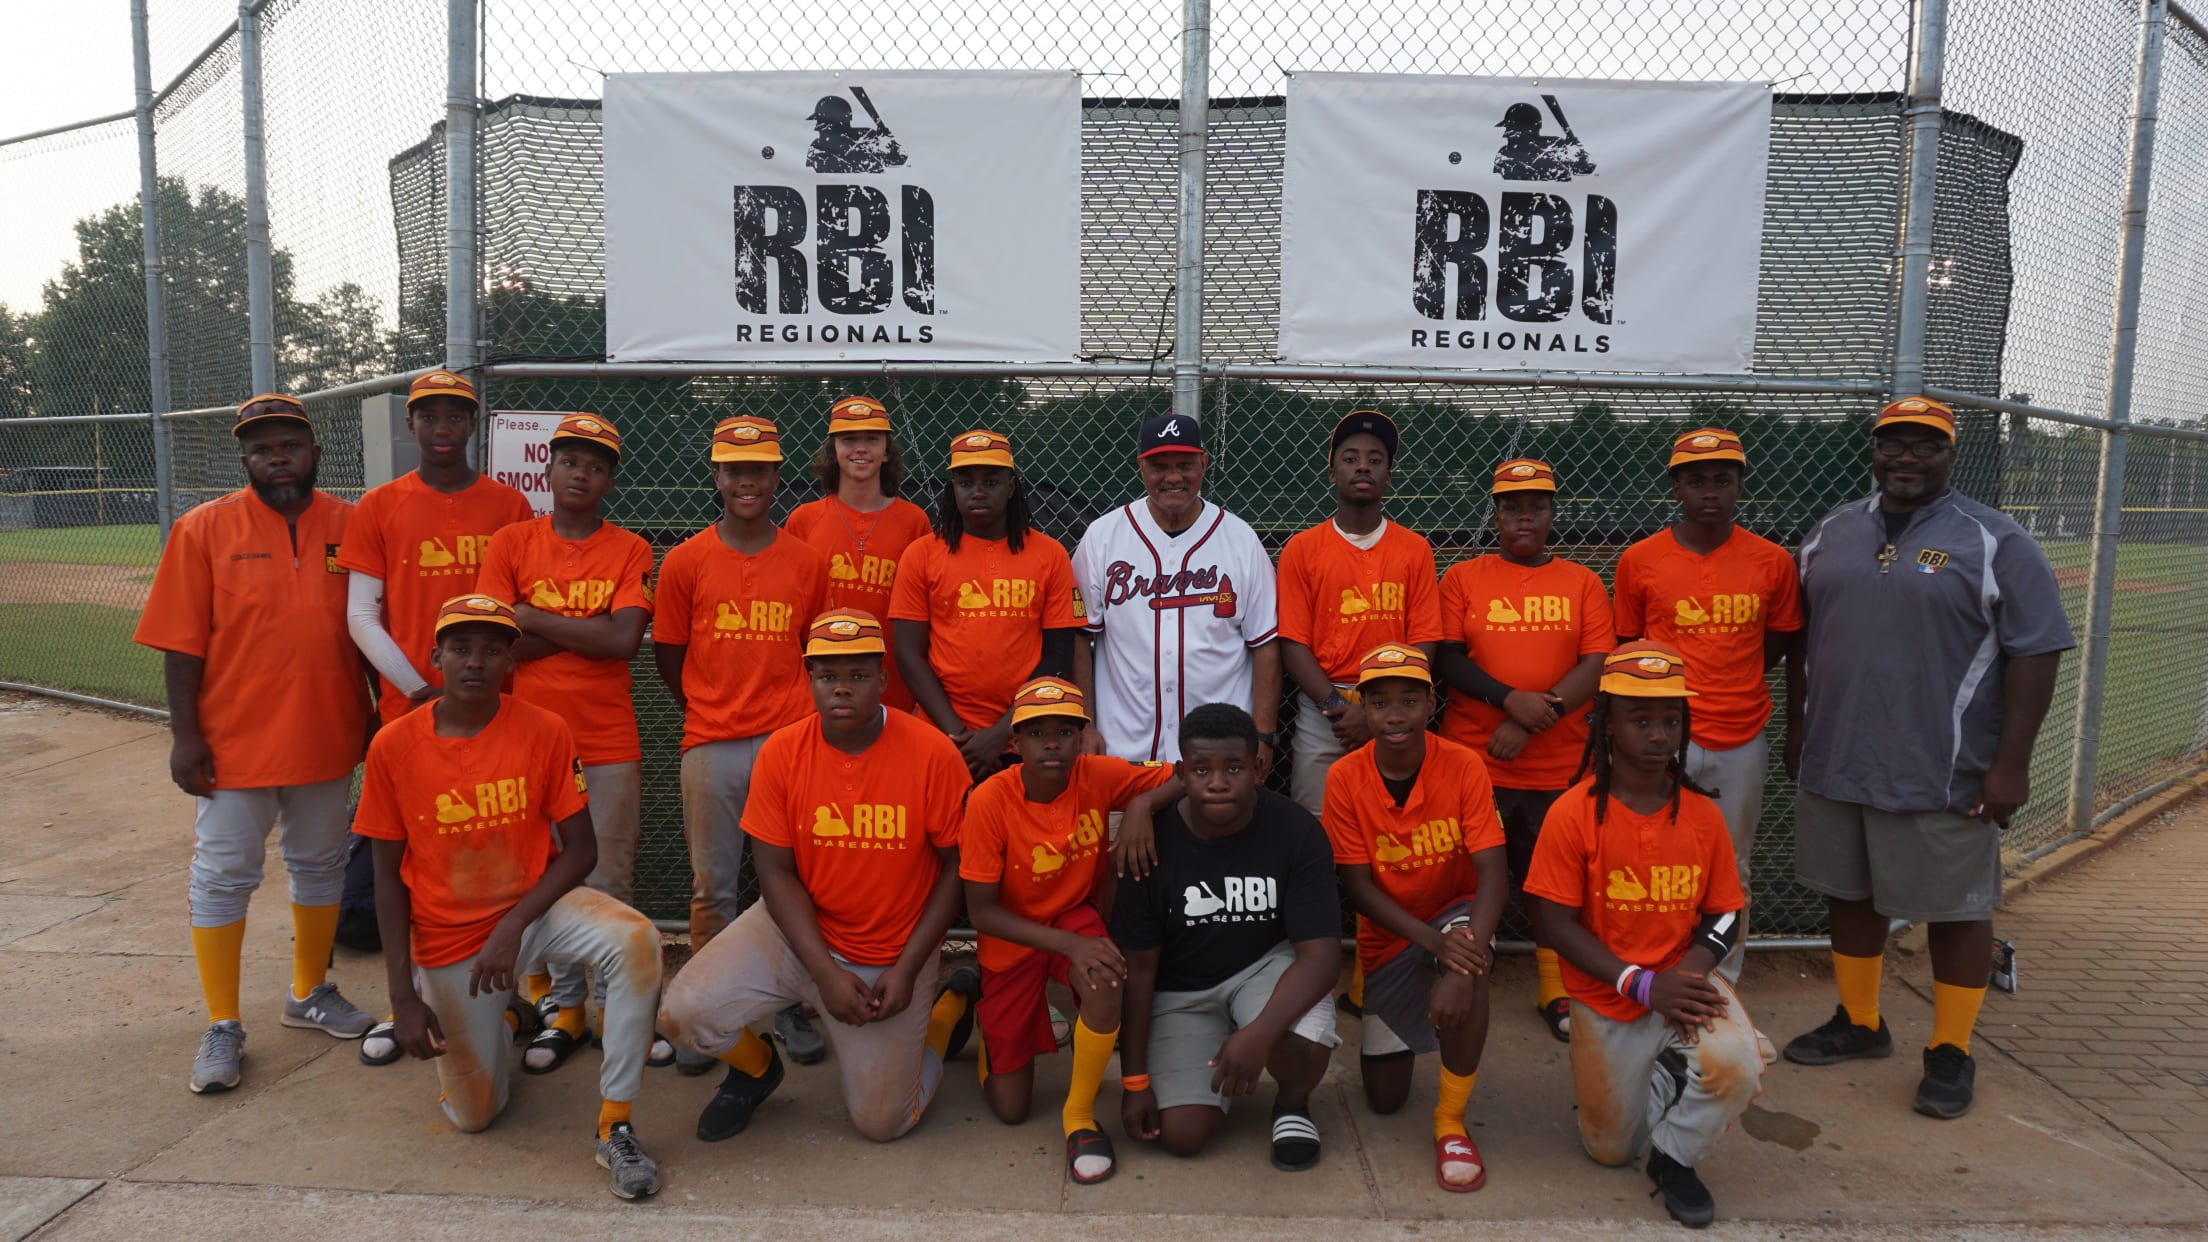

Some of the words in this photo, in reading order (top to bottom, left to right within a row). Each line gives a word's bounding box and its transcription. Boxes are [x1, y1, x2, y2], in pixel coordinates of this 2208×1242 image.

[733, 184, 935, 315] RBI
[1413, 189, 1618, 325] RBI
[736, 324, 934, 343] REGIONALS
[1411, 329, 1611, 354] REGIONALS
[497, 418, 549, 431] Please...
[1157, 420, 1180, 438] A
[524, 443, 549, 463] NO
[496, 471, 553, 493] SMOK
[419, 567, 475, 577] BASEB
[862, 555, 897, 587] RB
[1919, 550, 1948, 568] RBI
[568, 579, 615, 609] RBI
[830, 581, 890, 596] BASEBA
[993, 579, 1036, 608] RBI
[1105, 560, 1218, 610] Braves
[749, 600, 793, 632] RBI
[1524, 596, 1571, 623] RBI
[1713, 594, 1760, 624] RBI
[1486, 624, 1573, 632] BASEBALL
[475, 776, 527, 818] RBI
[853, 804, 906, 839] RBI
[813, 839, 907, 850] BASEBALL
[1412, 817, 1462, 857] RBI
[1224, 877, 1277, 912] RBI
[1651, 865, 1702, 902] RBI
[1185, 912, 1278, 927] BASEBALL
[1606, 902, 1696, 913] BASEBAL
